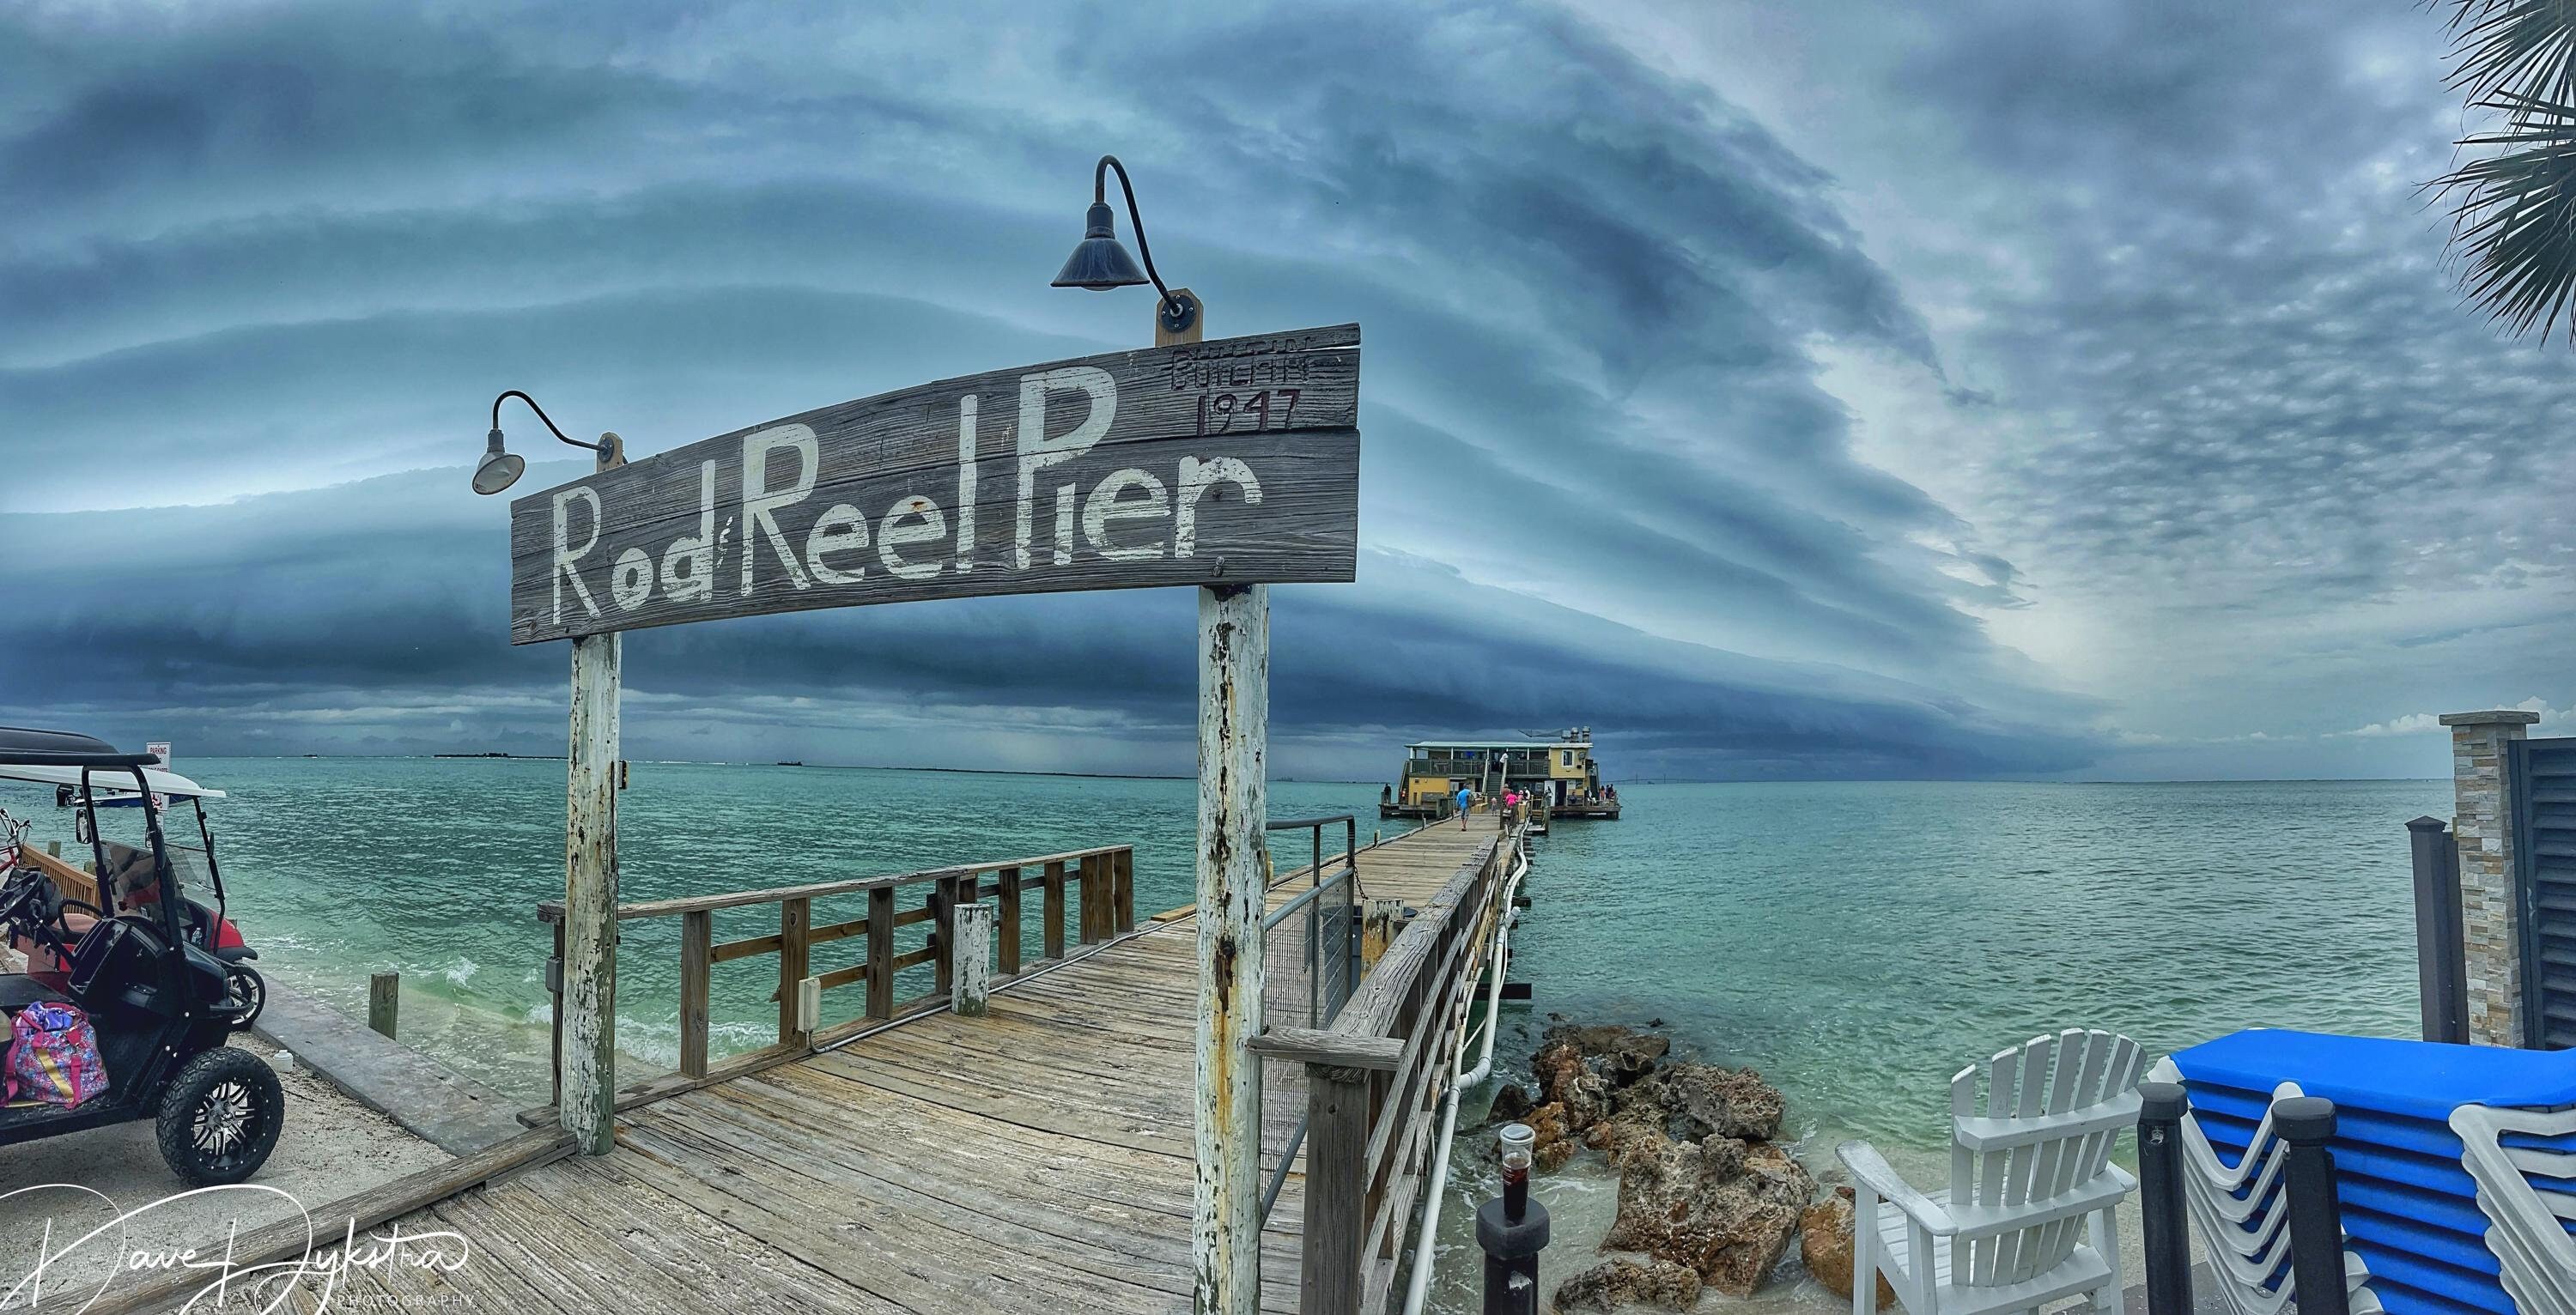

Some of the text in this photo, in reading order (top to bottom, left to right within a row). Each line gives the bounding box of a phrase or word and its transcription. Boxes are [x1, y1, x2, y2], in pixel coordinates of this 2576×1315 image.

[1197, 389, 1301, 436] 1947
[553, 460, 716, 624] Rod
[741, 395, 977, 597] Reel
[1016, 366, 1263, 568] Pier
